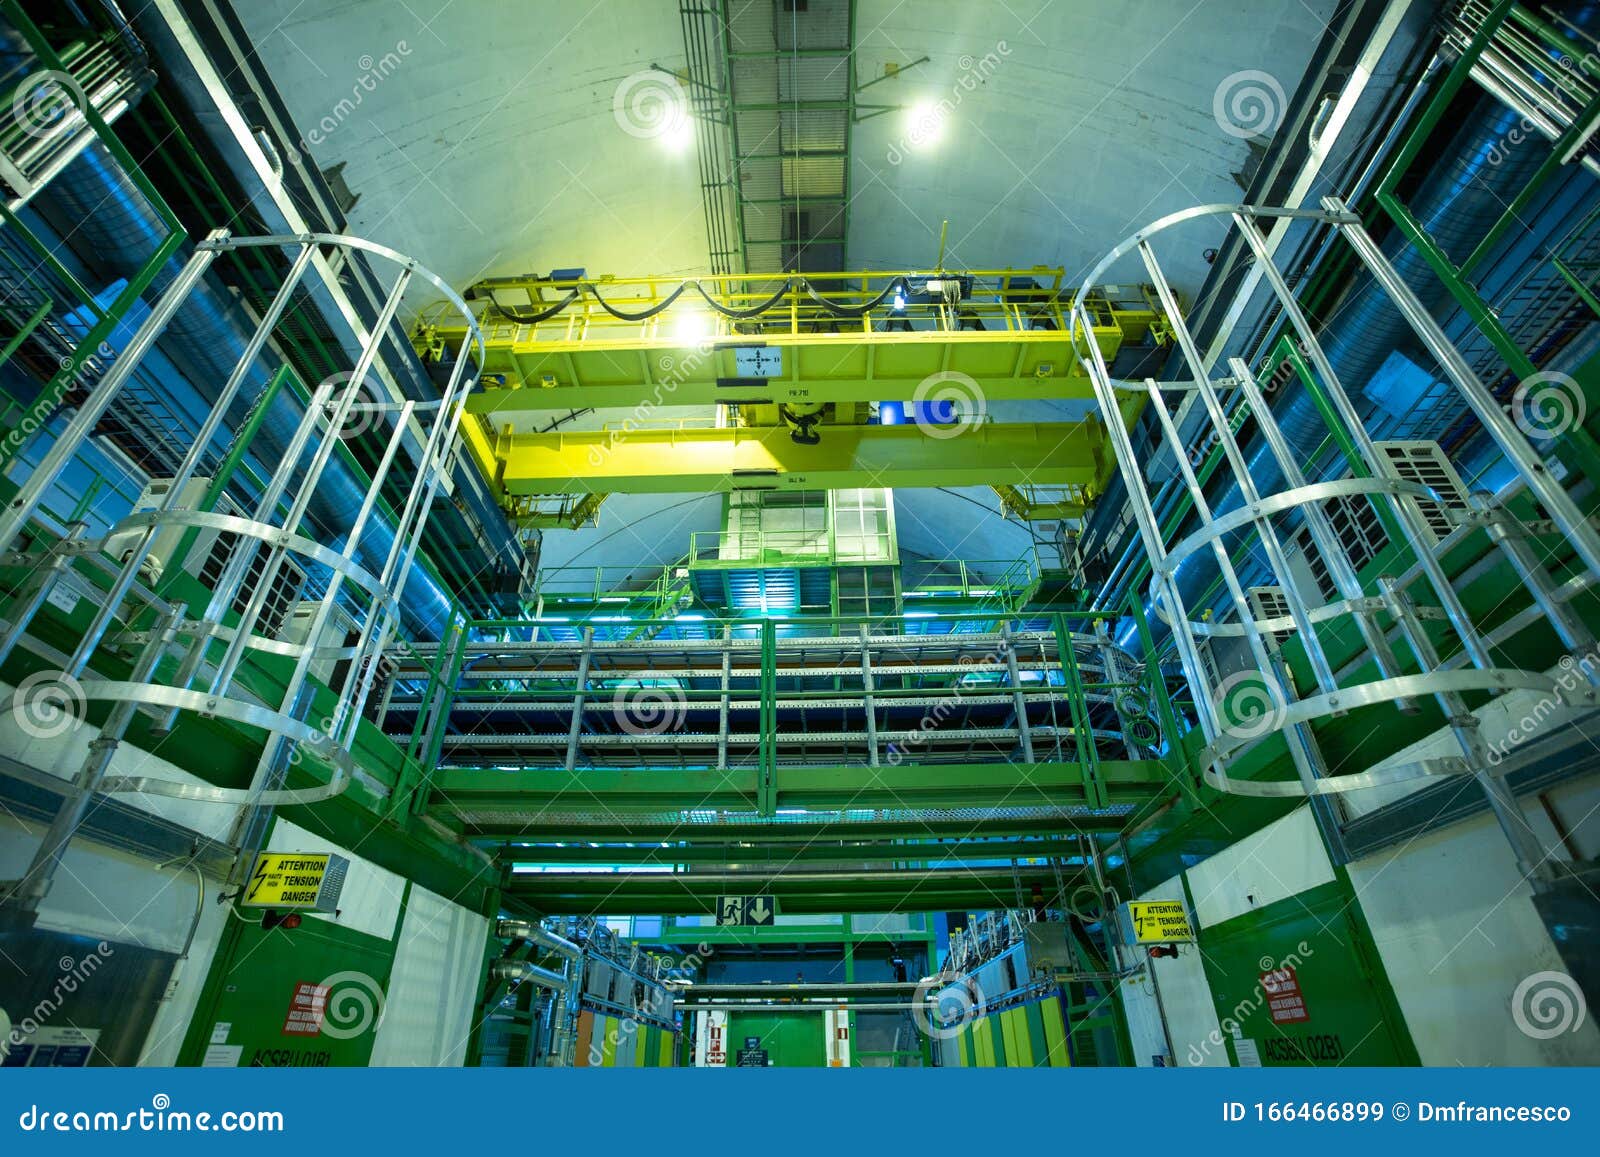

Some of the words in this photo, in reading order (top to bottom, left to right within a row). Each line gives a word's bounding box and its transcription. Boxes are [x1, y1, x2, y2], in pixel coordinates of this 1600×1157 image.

[277, 860, 327, 871] ATTENTION
[284, 876, 322, 887] TENSION
[280, 891, 317, 902] DANGER
[1147, 904, 1184, 914] ATTENTION
[1157, 916, 1187, 926] TENSION
[1162, 928, 1190, 937] DANGER
